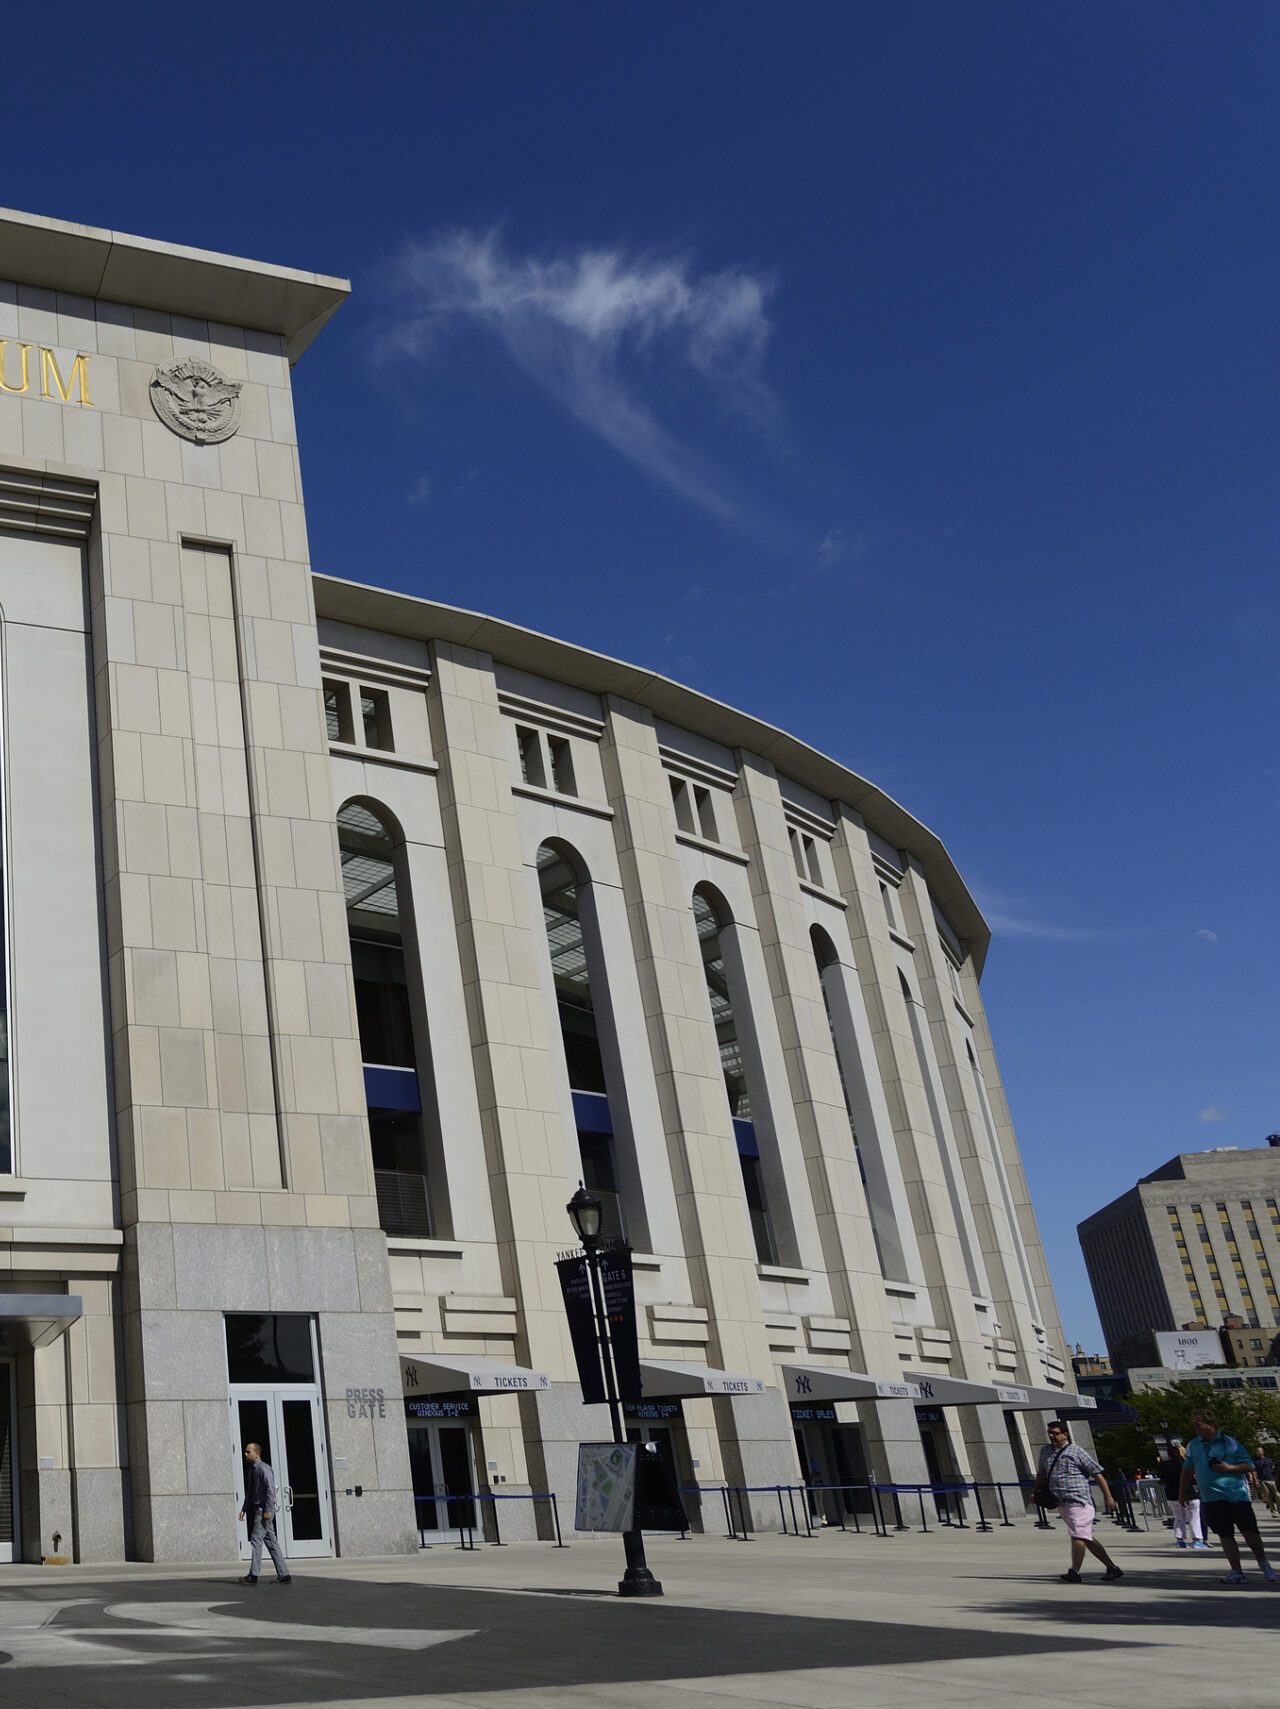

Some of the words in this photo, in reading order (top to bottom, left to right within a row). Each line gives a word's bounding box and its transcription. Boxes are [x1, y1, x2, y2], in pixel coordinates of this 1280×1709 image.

[494, 1377, 528, 1388] TICKETS
[722, 1381, 749, 1392] TICKETS
[346, 1388, 385, 1404] PRESS
[889, 1386, 909, 1396] TICKETS
[347, 1403, 386, 1419] GATE
[409, 1402, 440, 1411] CUSTOMER
[442, 1402, 469, 1411] SERVICE
[417, 1409, 444, 1417] WINDOWS
[447, 1409, 459, 1417] 1-2
[792, 1409, 813, 1419] TICKET
